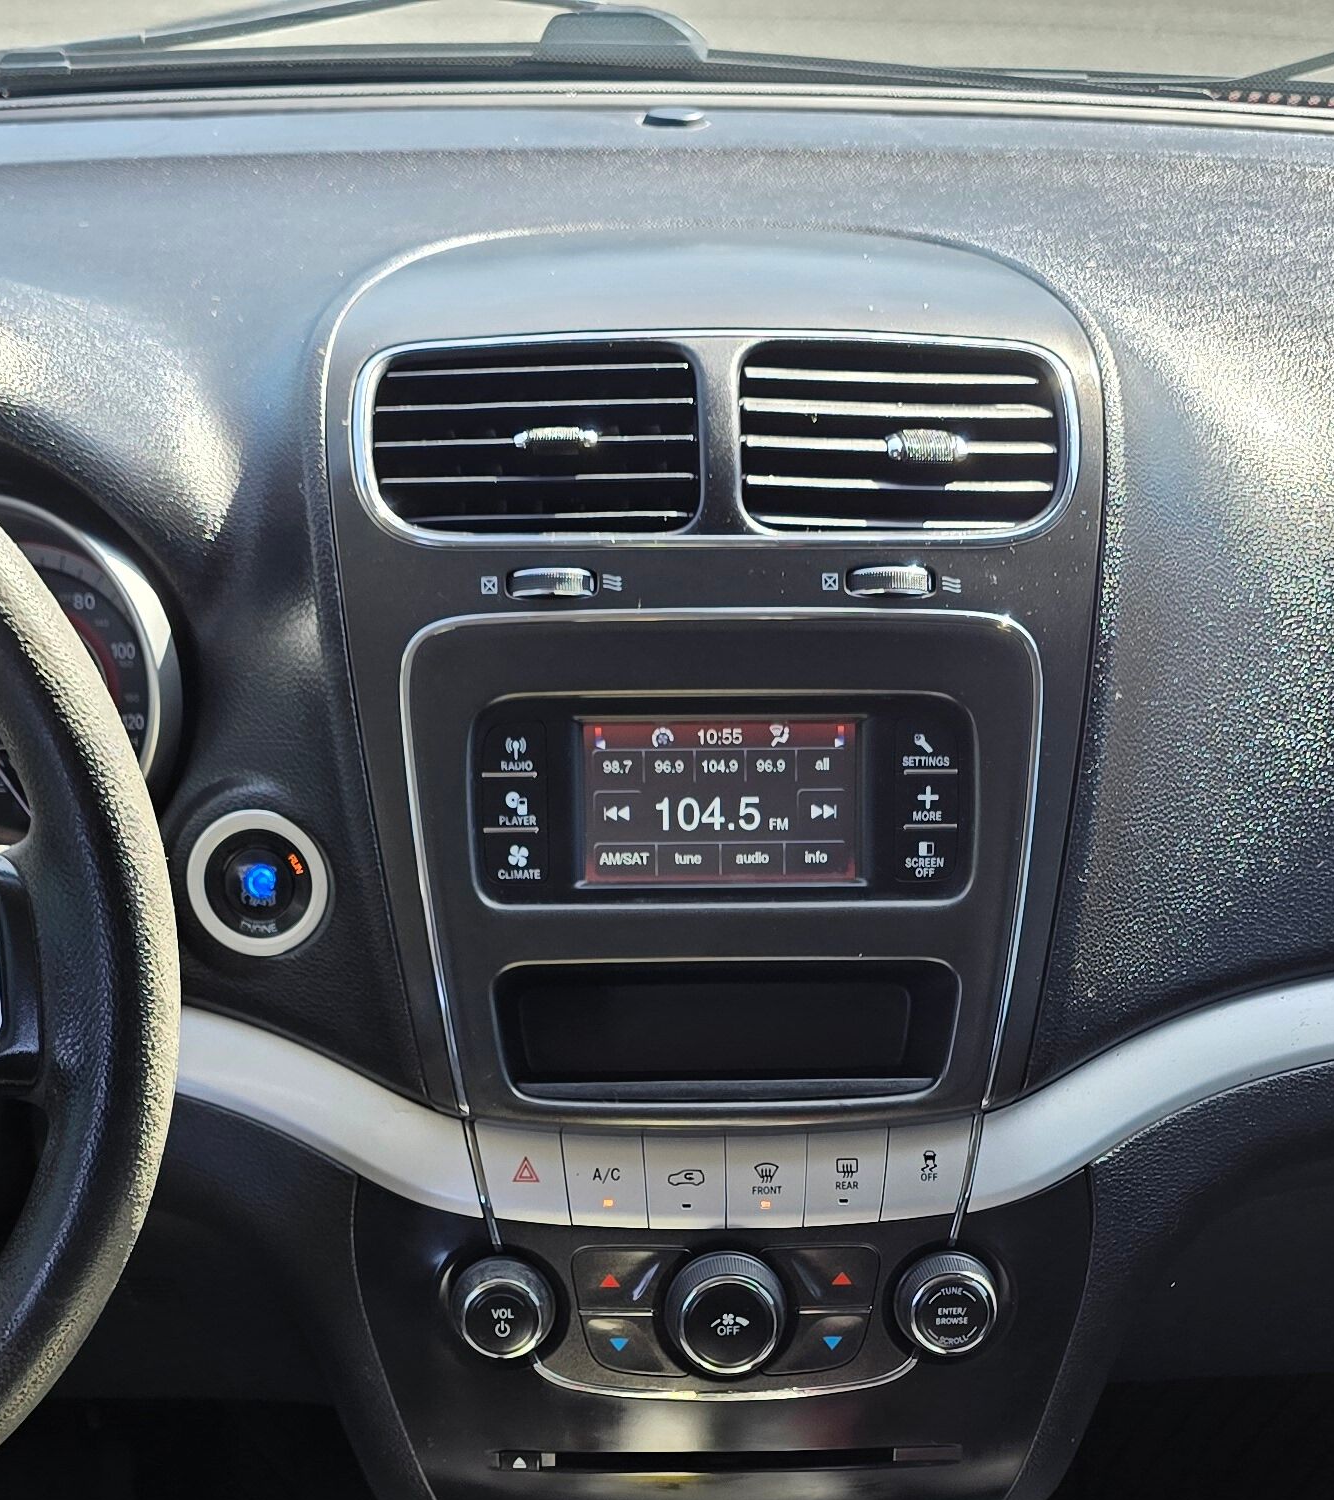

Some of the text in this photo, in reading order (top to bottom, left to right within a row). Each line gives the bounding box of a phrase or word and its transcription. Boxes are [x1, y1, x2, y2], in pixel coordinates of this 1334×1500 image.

[73, 592, 96, 610] 80
[111, 642, 136, 660] 100
[697, 728, 743, 746] 10:55
[500, 760, 534, 771] RADIO
[654, 760, 684, 775] 96.9
[701, 760, 739, 774] 104.9
[756, 759, 786, 774] 96.9
[814, 757, 830, 773] all
[902, 756, 950, 767] SETTINGS
[655, 796, 789, 832] 104.5 FM
[912, 811, 942, 821] MORE
[498, 815, 537, 826] PLAYER
[599, 851, 650, 867] AM/SAT
[674, 853, 702, 865] tune
[735, 851, 769, 865] audio
[804, 850, 828, 864] info
[904, 857, 945, 868] SCREEN
[287, 853, 304, 875] RUN
[497, 868, 541, 880] CLIMATE
[915, 867, 935, 878] OFF
[592, 1166, 621, 1183] A/C
[919, 1171, 938, 1182] OFF
[751, 1184, 783, 1196] FRONT
[835, 1180, 859, 1191] REAR
[940, 1286, 963, 1296] TUNE
[491, 1309, 515, 1321] VOL
[937, 1307, 967, 1316] ENTER/
[935, 1317, 968, 1325] BROWSE
[716, 1324, 741, 1337] OFF
[938, 1335, 968, 1345] SCROLL
